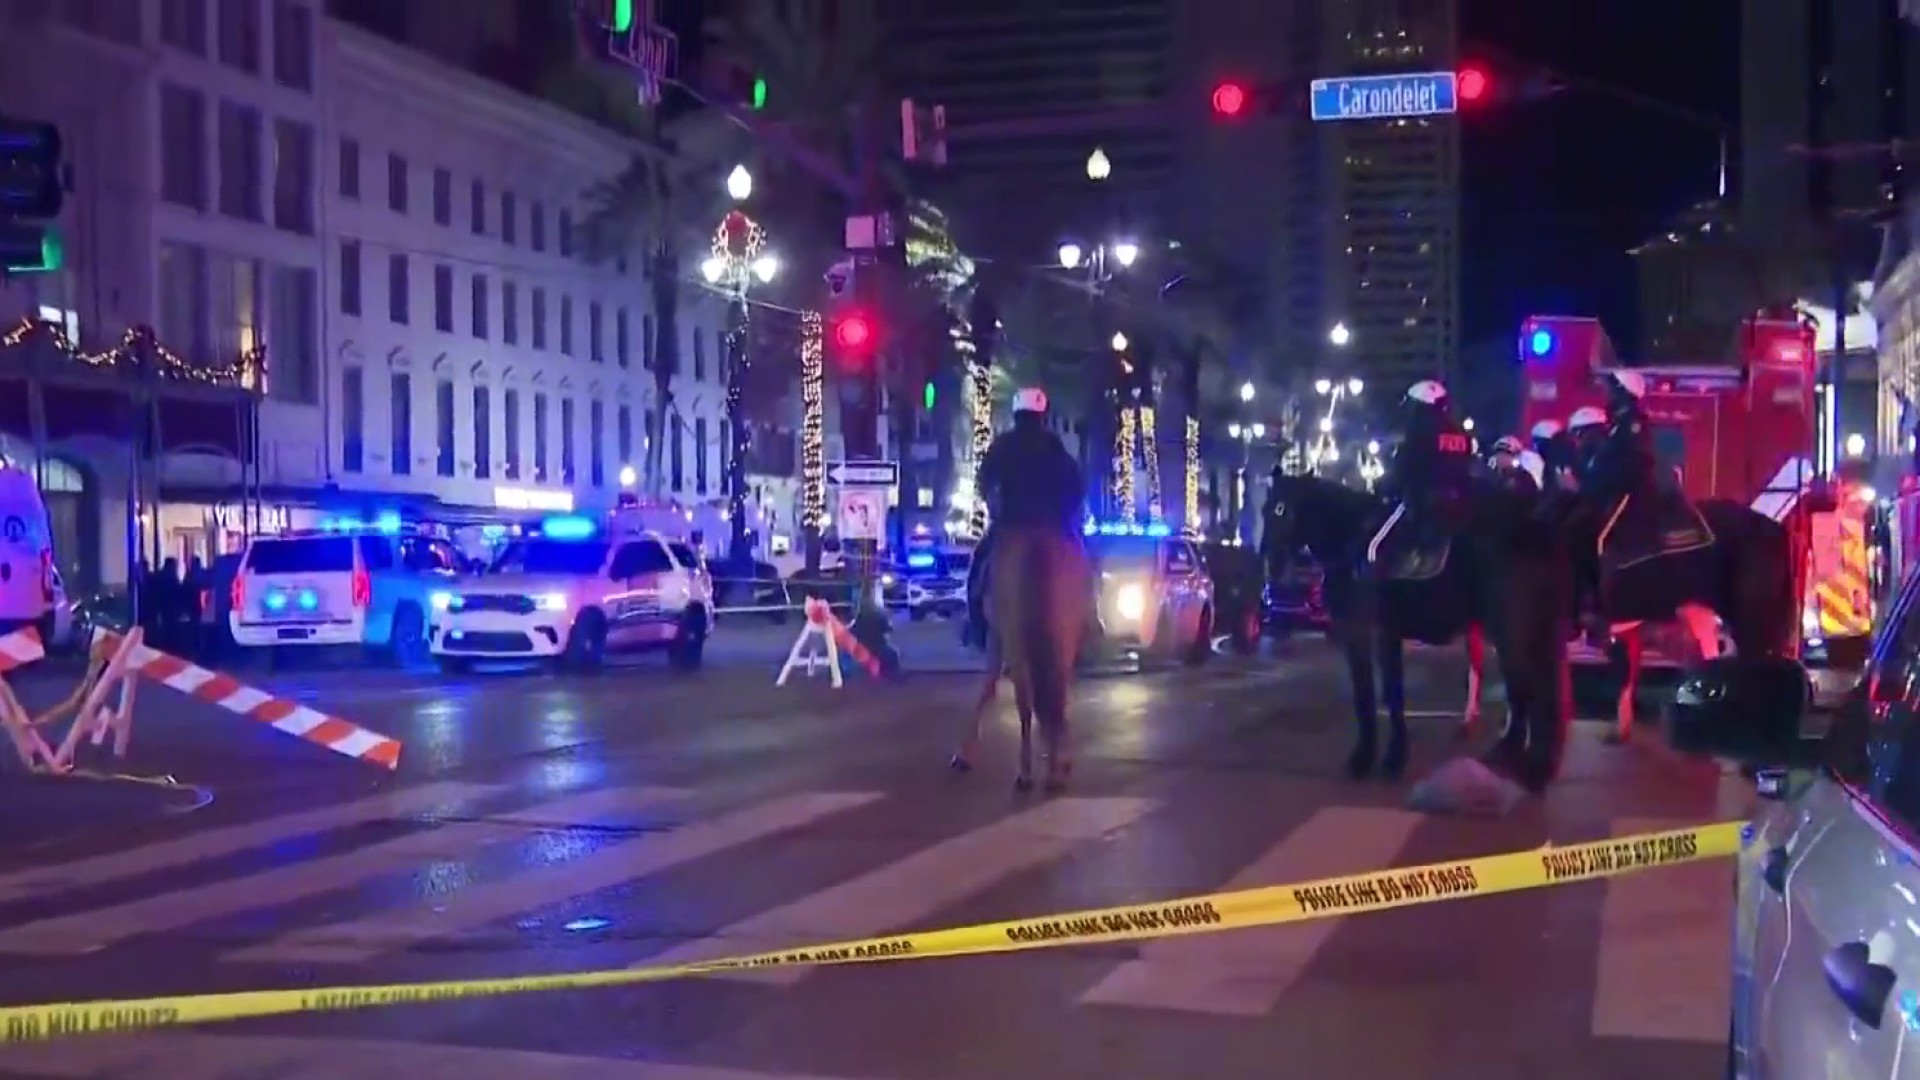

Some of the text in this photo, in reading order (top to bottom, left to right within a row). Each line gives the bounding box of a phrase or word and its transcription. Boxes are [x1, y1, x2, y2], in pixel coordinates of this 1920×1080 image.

[1338, 79, 1437, 115] Carondelet
[1541, 852, 1586, 880] POLICE
[1633, 840, 1657, 865] NOT
[1659, 833, 1698, 863] CROSS
[1293, 865, 1479, 912] POLICE LINE DO NOT CROSS
